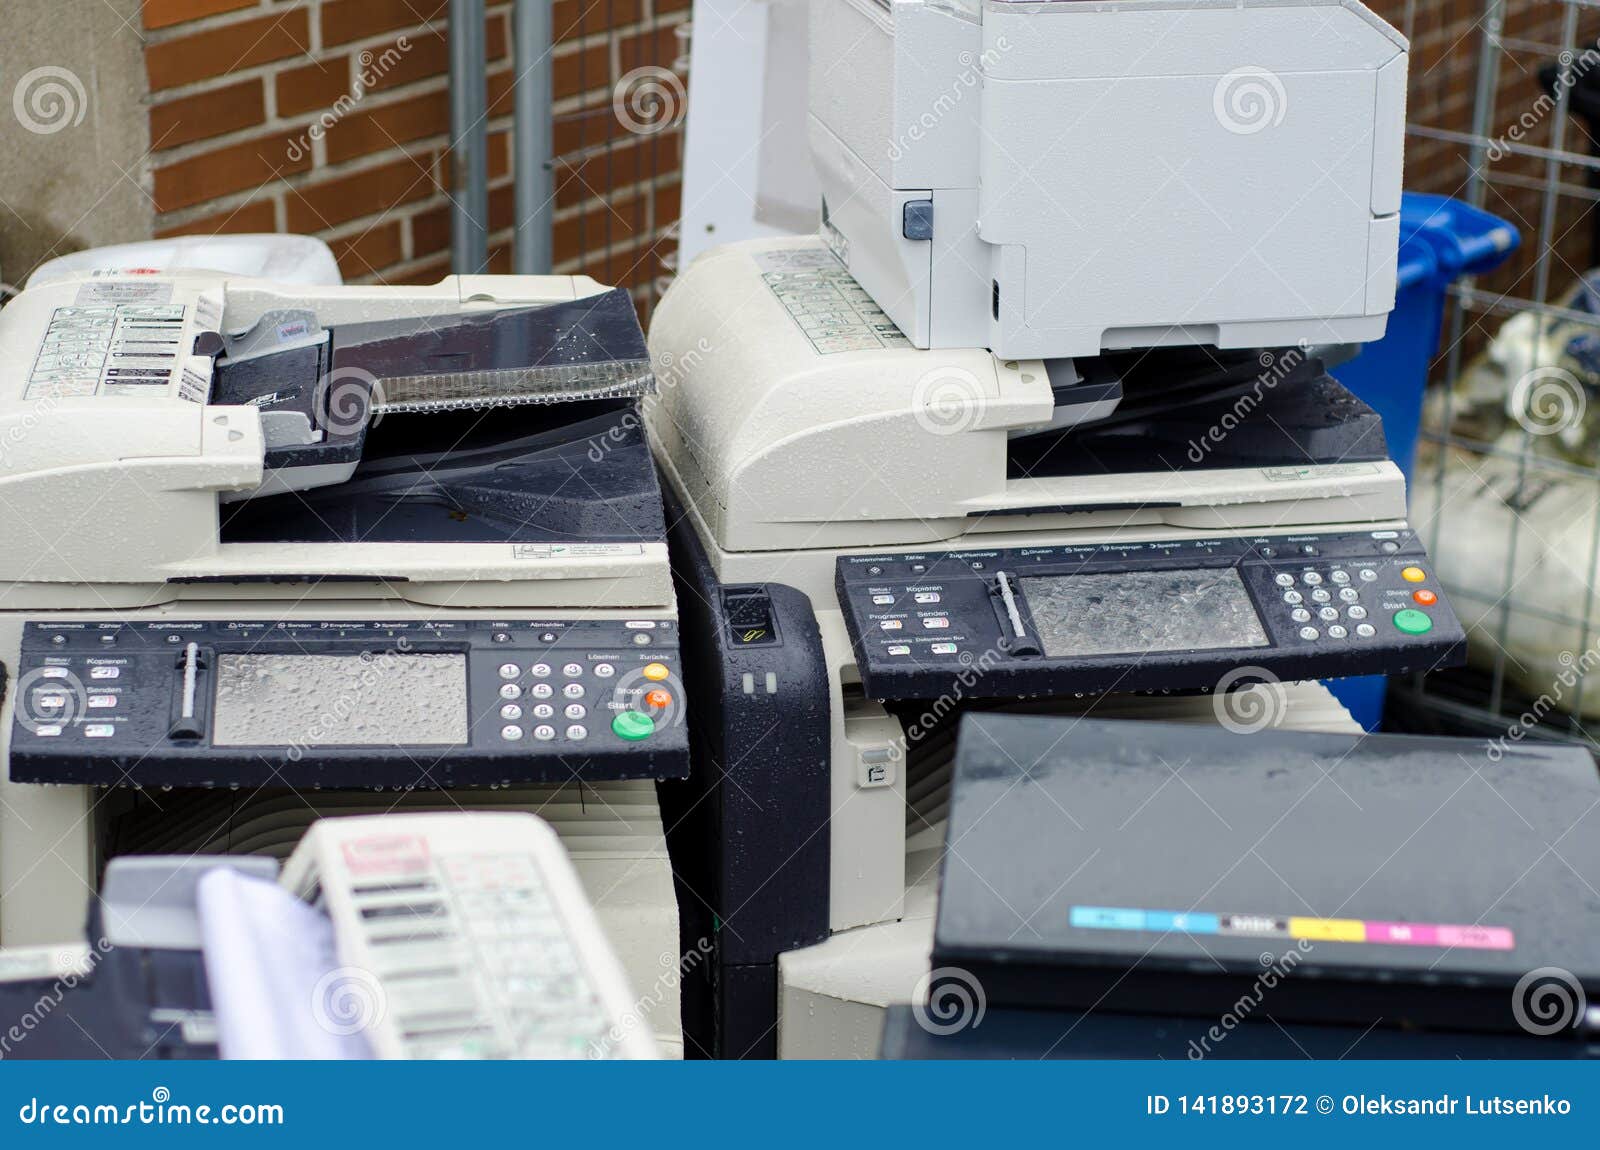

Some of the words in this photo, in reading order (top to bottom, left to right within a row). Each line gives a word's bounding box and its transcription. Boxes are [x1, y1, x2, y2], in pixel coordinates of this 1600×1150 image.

[906, 585, 943, 593] Kopieren
[86, 658, 128, 666] Kopieren
[608, 701, 634, 709] Start
